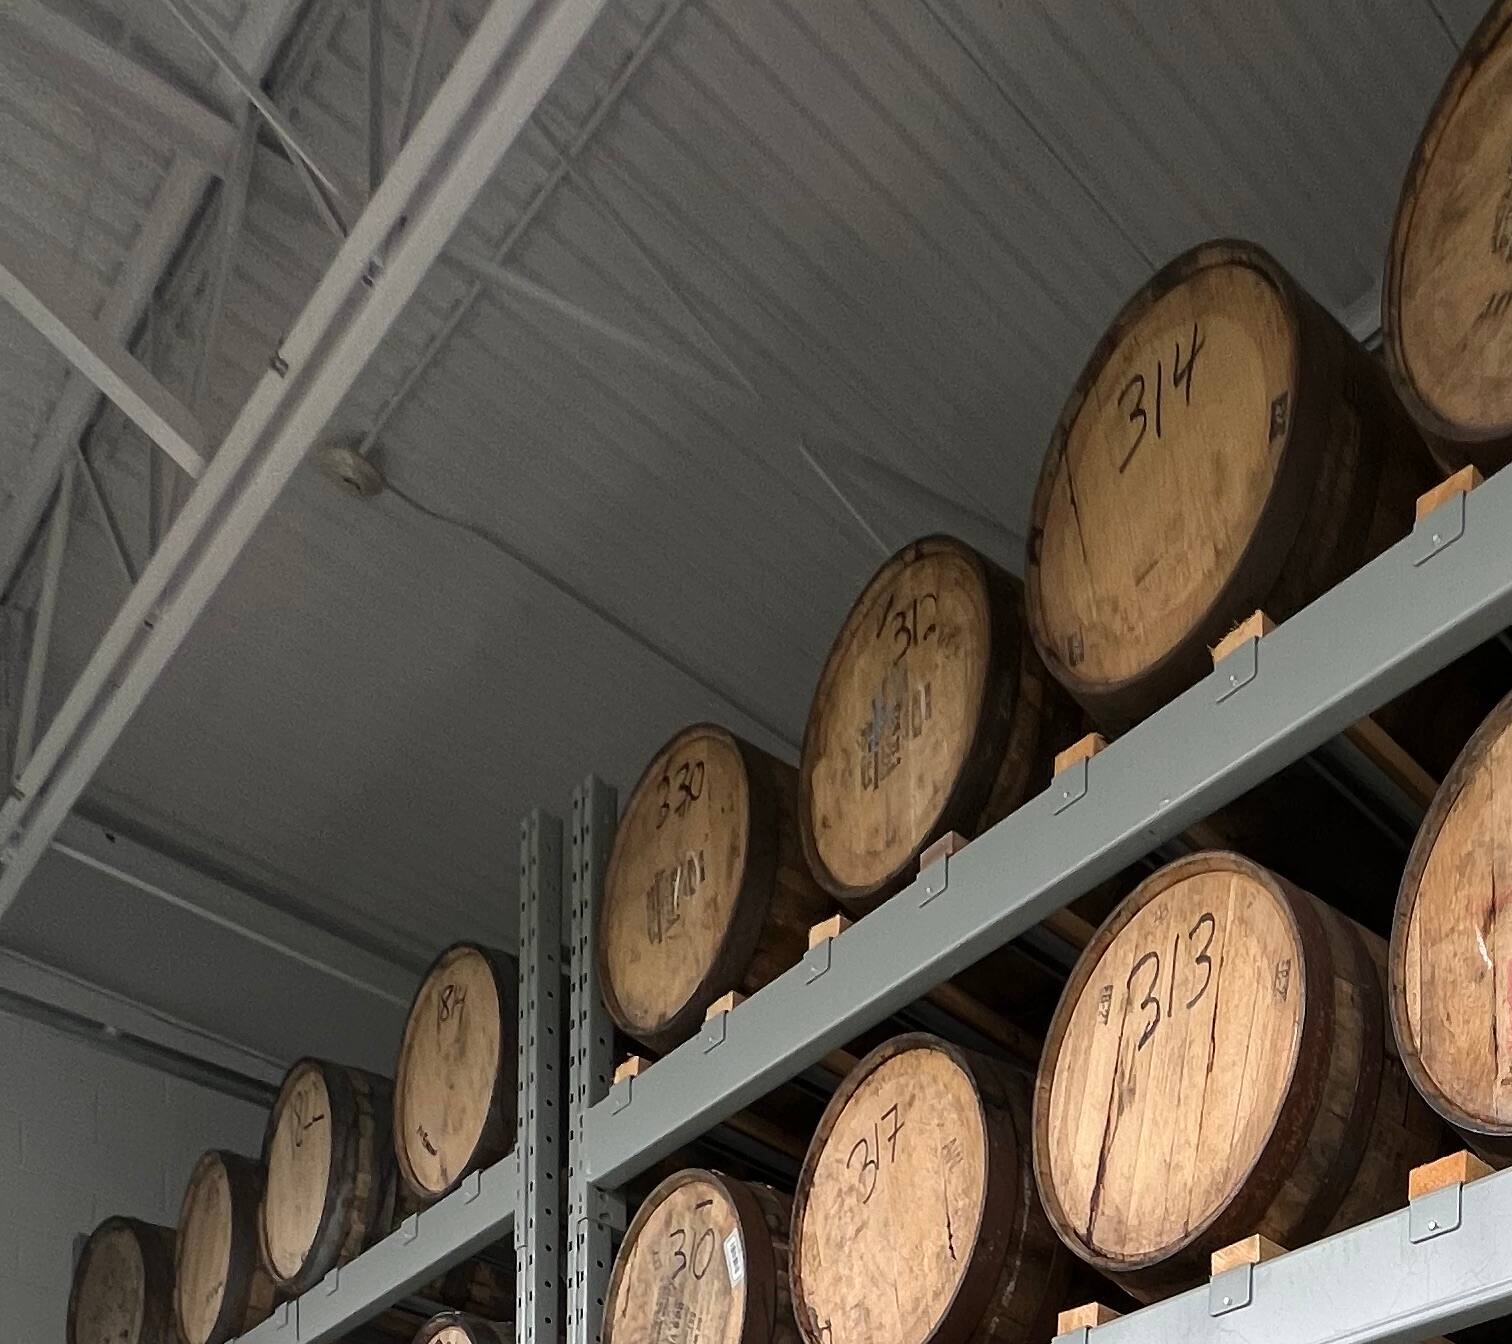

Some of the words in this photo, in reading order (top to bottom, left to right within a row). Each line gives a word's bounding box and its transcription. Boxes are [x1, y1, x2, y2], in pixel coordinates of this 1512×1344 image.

[1117, 322, 1206, 474] 314
[1125, 912, 1216, 1052] 313
[846, 1103, 905, 1205] 317
